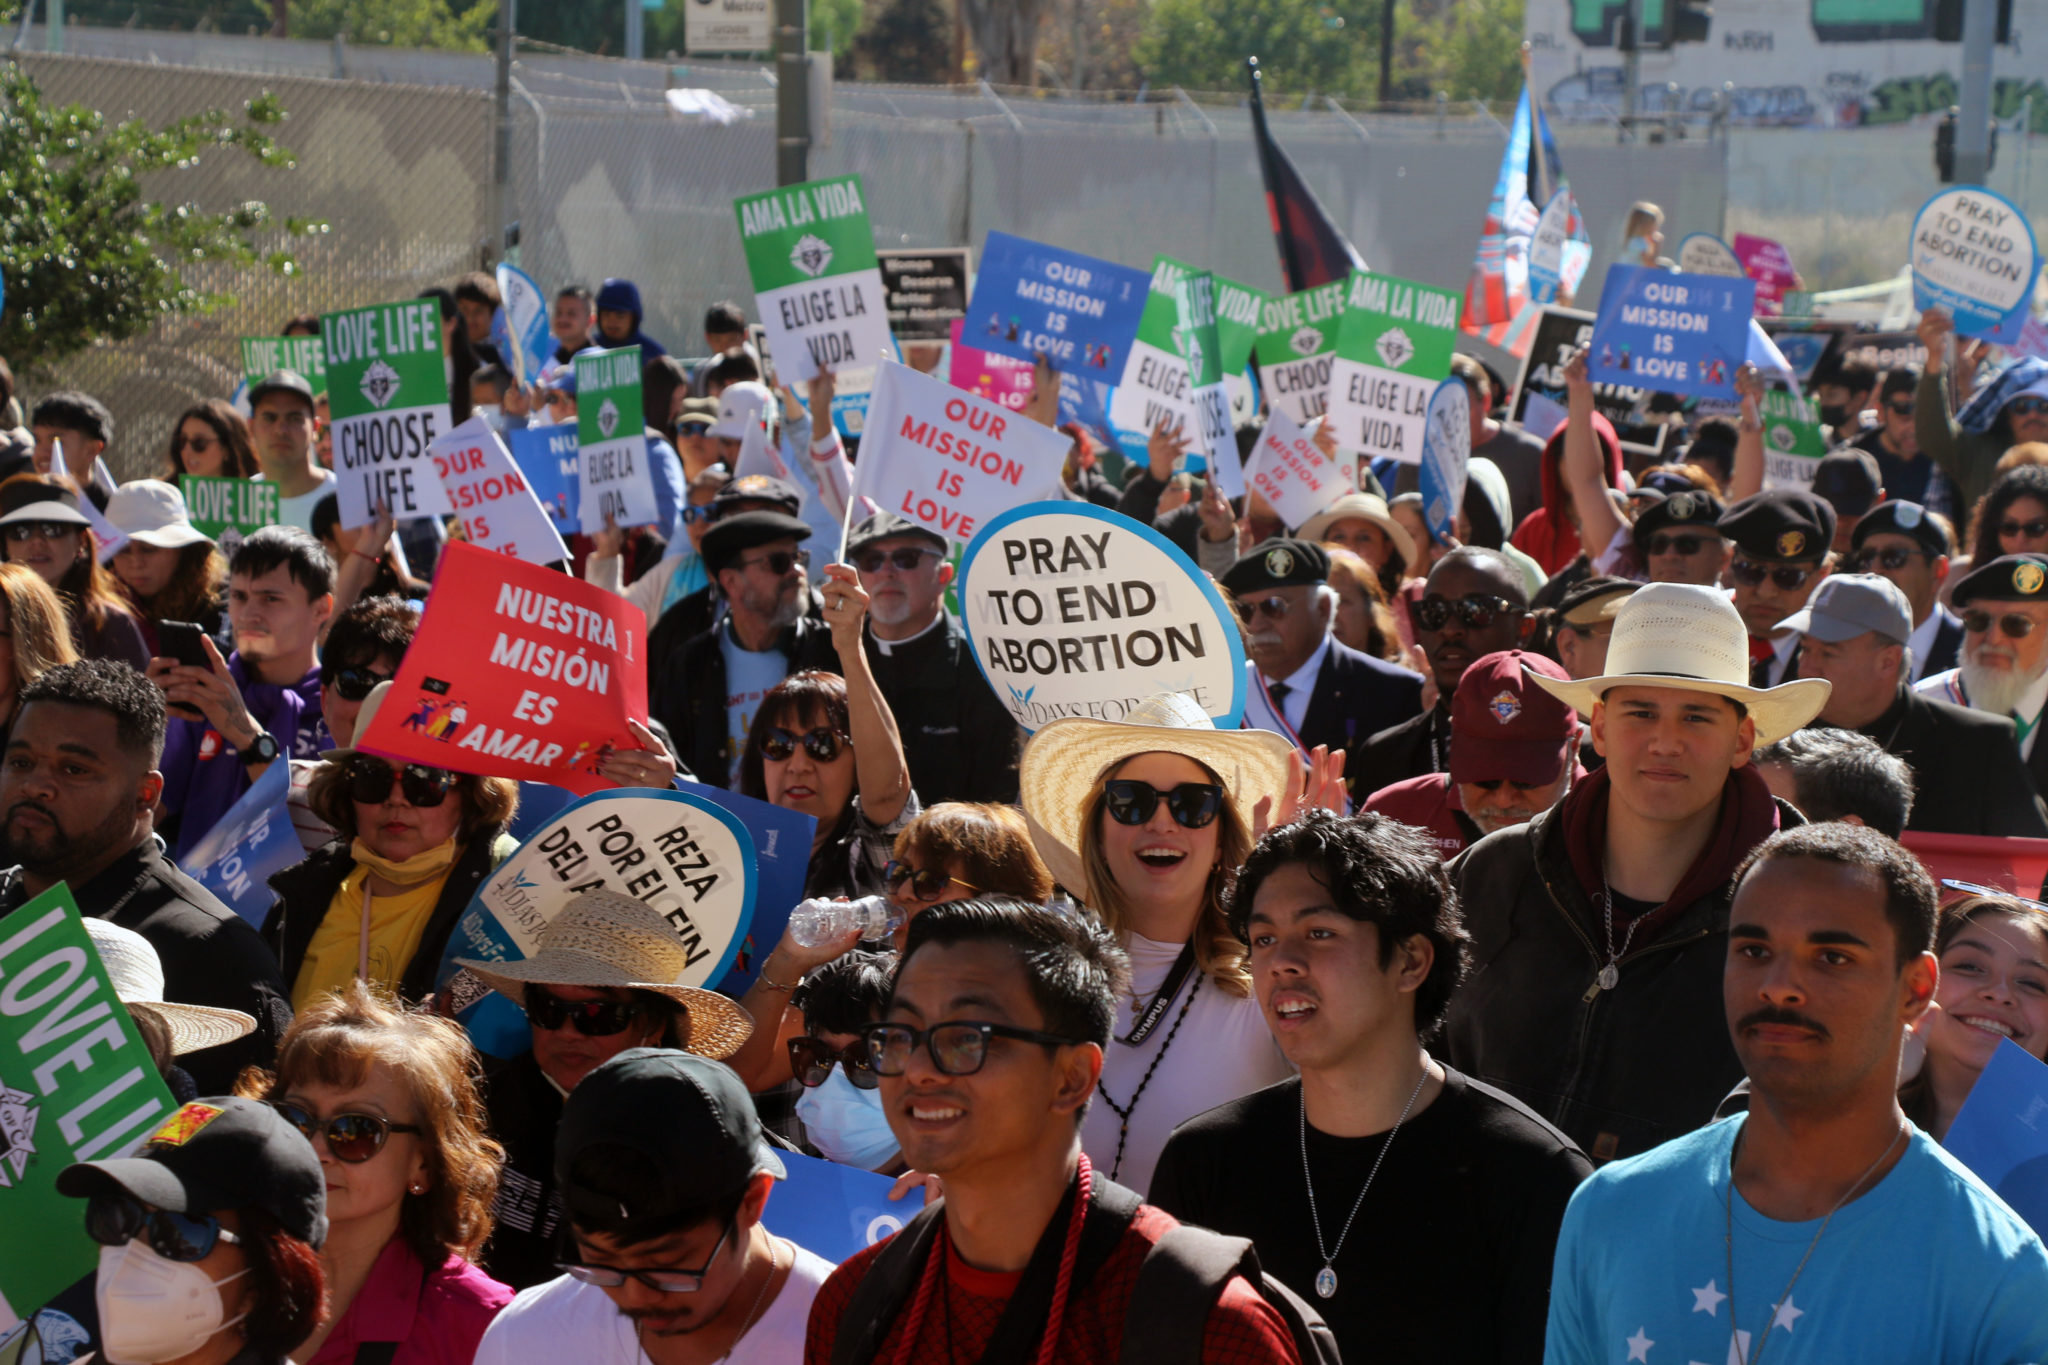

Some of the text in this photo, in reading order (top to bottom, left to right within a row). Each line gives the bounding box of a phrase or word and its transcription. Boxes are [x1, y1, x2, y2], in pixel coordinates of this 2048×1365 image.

[741, 180, 864, 237] AMA LA VIDA
[1955, 196, 2010, 227] PRAY
[1936, 211, 2014, 254] TO END
[1044, 261, 1092, 288] OUR
[1918, 229, 2022, 282] ABORTION
[779, 283, 867, 331] ELIGE LA
[1016, 278, 1106, 318] MISSION
[1217, 284, 1262, 327] VIDA
[1257, 296, 1301, 336] OVE
[1350, 275, 1457, 330] AMA LA VIDA
[1643, 283, 1689, 306] OUR
[325, 304, 437, 365] LOVE LIFE
[1045, 312, 1068, 332] IS
[1621, 304, 1709, 334] MISSION
[243, 338, 325, 377] LOVE LIFE
[806, 330, 856, 367] VIDA
[1022, 330, 1075, 359] LOVE
[1653, 334, 1674, 354] IS
[614, 352, 641, 386] VIDA
[1015, 371, 1032, 388] IS
[1137, 355, 1190, 399] ELIGE
[1635, 356, 1688, 380] LOVE
[999, 391, 1025, 409] LO
[1348, 372, 1426, 418] ELIGE LA
[341, 412, 437, 470] CHOOSE
[945, 398, 1007, 441] OUR
[1362, 416, 1404, 452] VIDA
[617, 447, 634, 479] LA
[899, 414, 1024, 487] MISSION
[1267, 434, 1323, 492] MISSION
[1293, 438, 1324, 468] OUR
[364, 468, 417, 518] LIFE
[936, 468, 965, 498] IS
[1254, 473, 1285, 502] OVE
[1271, 465, 1288, 482] IS
[184, 479, 276, 526] LOVE LIFE
[900, 490, 975, 539] LOVE
[463, 516, 491, 542] IS
[1003, 531, 1111, 577] PRAY
[495, 582, 618, 651] NUESTRA
[987, 579, 1157, 626] TO END
[489, 632, 609, 695] MISIÓN
[987, 622, 1206, 676] ABORTION
[512, 689, 560, 726] ES
[458, 724, 563, 767] AMAR
[537, 825, 589, 883] DEL
[586, 813, 647, 877] POR
[653, 824, 720, 905] REZA
[0, 906, 128, 1097] LOVE
[1131, 997, 1168, 1042] OLYMPUS
